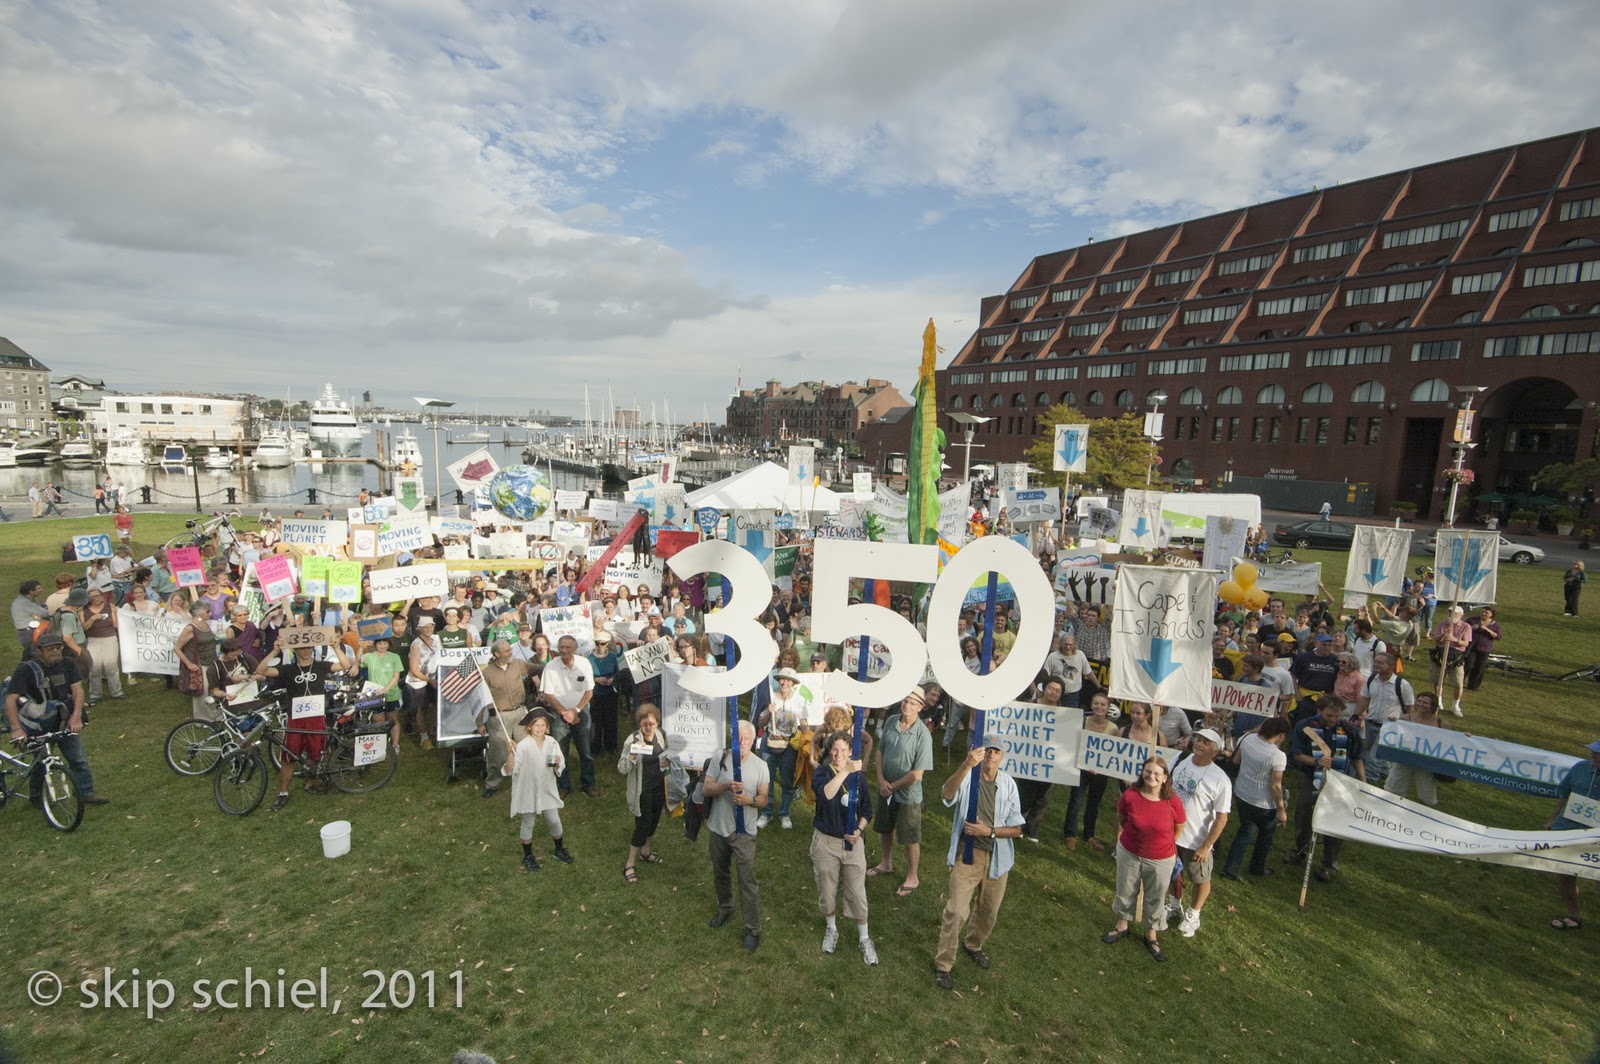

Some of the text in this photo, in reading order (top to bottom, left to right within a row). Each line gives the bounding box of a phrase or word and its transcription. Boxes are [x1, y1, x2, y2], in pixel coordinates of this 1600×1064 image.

[1004, 469, 1024, 478] Rhode
[1001, 478, 1023, 487] Island
[448, 520, 467, 531] 350
[701, 512, 718, 525] 350
[1092, 512, 1112, 524] ZERO
[283, 524, 326, 534] MOVING
[378, 526, 422, 542] MOVING
[76, 534, 112, 558] 350
[283, 533, 326, 544] PLANET
[382, 537, 423, 553] PLANET
[1165, 553, 1200, 568] CLIMATE
[606, 570, 639, 578] MOVING
[372, 575, 442, 592] www.350.org
[1137, 580, 1186, 622] Cape
[132, 616, 182, 632] MOVING
[1115, 608, 1206, 640] Islands
[136, 631, 179, 647] BEYON
[137, 648, 179, 664] FOSSIL
[441, 649, 482, 658] BOSTON
[627, 641, 670, 666] TAR SANDS
[674, 701, 712, 710] JUSTICE
[1222, 685, 1275, 713] POWER!
[678, 714, 708, 723] PEACE
[988, 706, 1056, 724] MOVING
[674, 725, 713, 734] DIGNITY
[986, 718, 1055, 742] PLANET
[358, 736, 381, 744] MAKE
[1005, 740, 1056, 761] OVING
[1382, 730, 1570, 785] CLIMATE ACTIO
[1085, 750, 1144, 777] PLANE
[1459, 768, 1562, 798] www.climateact
[1354, 807, 1414, 837] Climate
